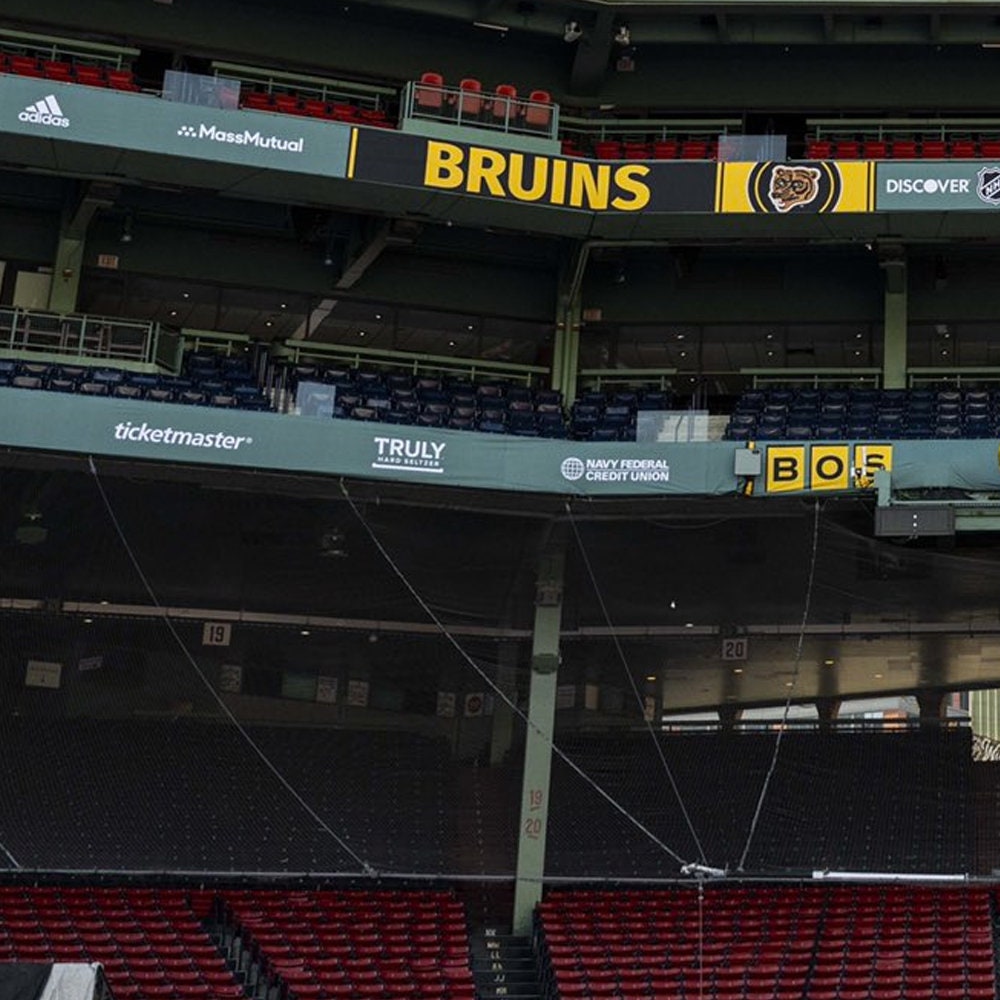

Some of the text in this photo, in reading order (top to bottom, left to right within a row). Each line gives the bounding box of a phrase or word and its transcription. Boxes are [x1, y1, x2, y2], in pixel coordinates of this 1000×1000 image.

[18, 111, 70, 128] adidas
[199, 123, 304, 152] MassMutual
[424, 140, 651, 211] BRUINS
[886, 178, 969, 193] DISCOVER
[114, 421, 245, 451] ticketmaster
[374, 437, 446, 459] TRULY
[586, 459, 669, 469] NAVY FEDERAL
[585, 471, 669, 481] CREDIT UNION
[209, 626, 224, 642] 19
[726, 642, 744, 657] 20
[525, 818, 541, 833] 20
